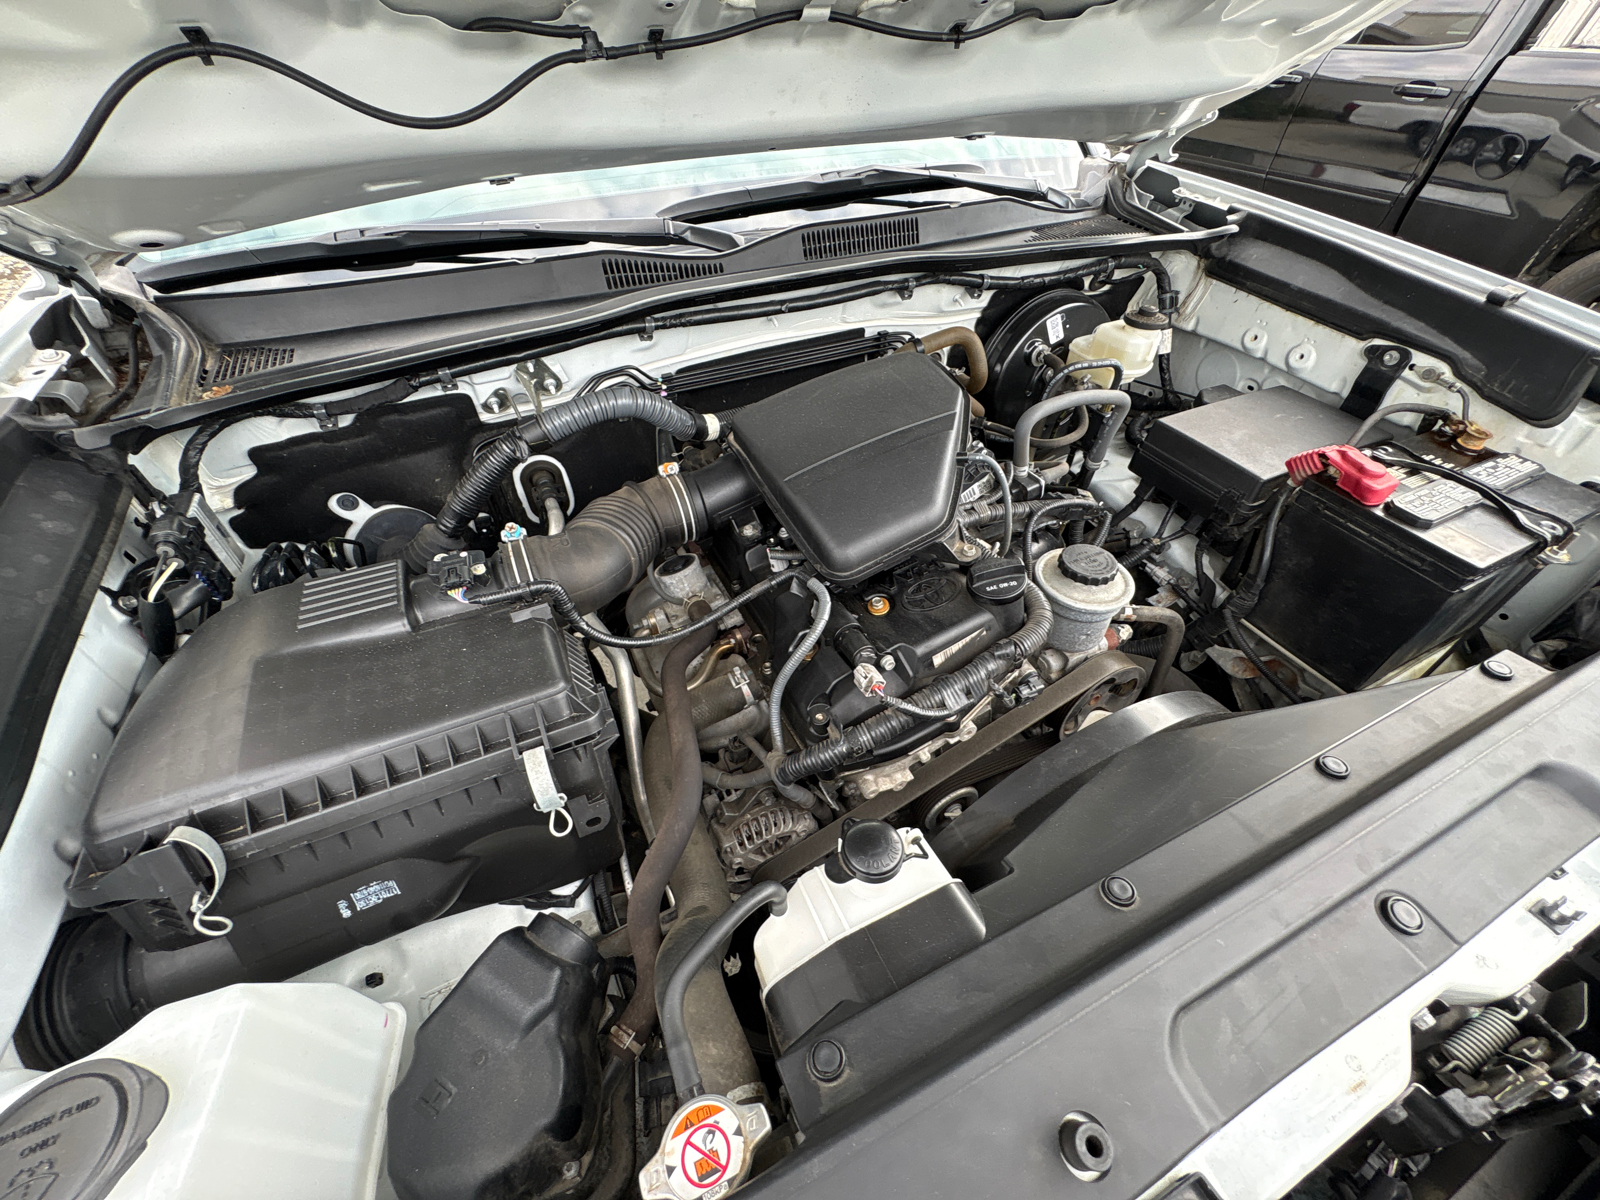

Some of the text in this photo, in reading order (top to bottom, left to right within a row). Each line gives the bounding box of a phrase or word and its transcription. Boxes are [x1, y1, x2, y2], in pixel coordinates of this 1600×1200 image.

[985, 580, 1018, 592] SAE 0W-20
[857, 837, 900, 870] COOLANT
[58, 1096, 101, 1122] FLUID
[19, 1132, 61, 1159] ONLY
